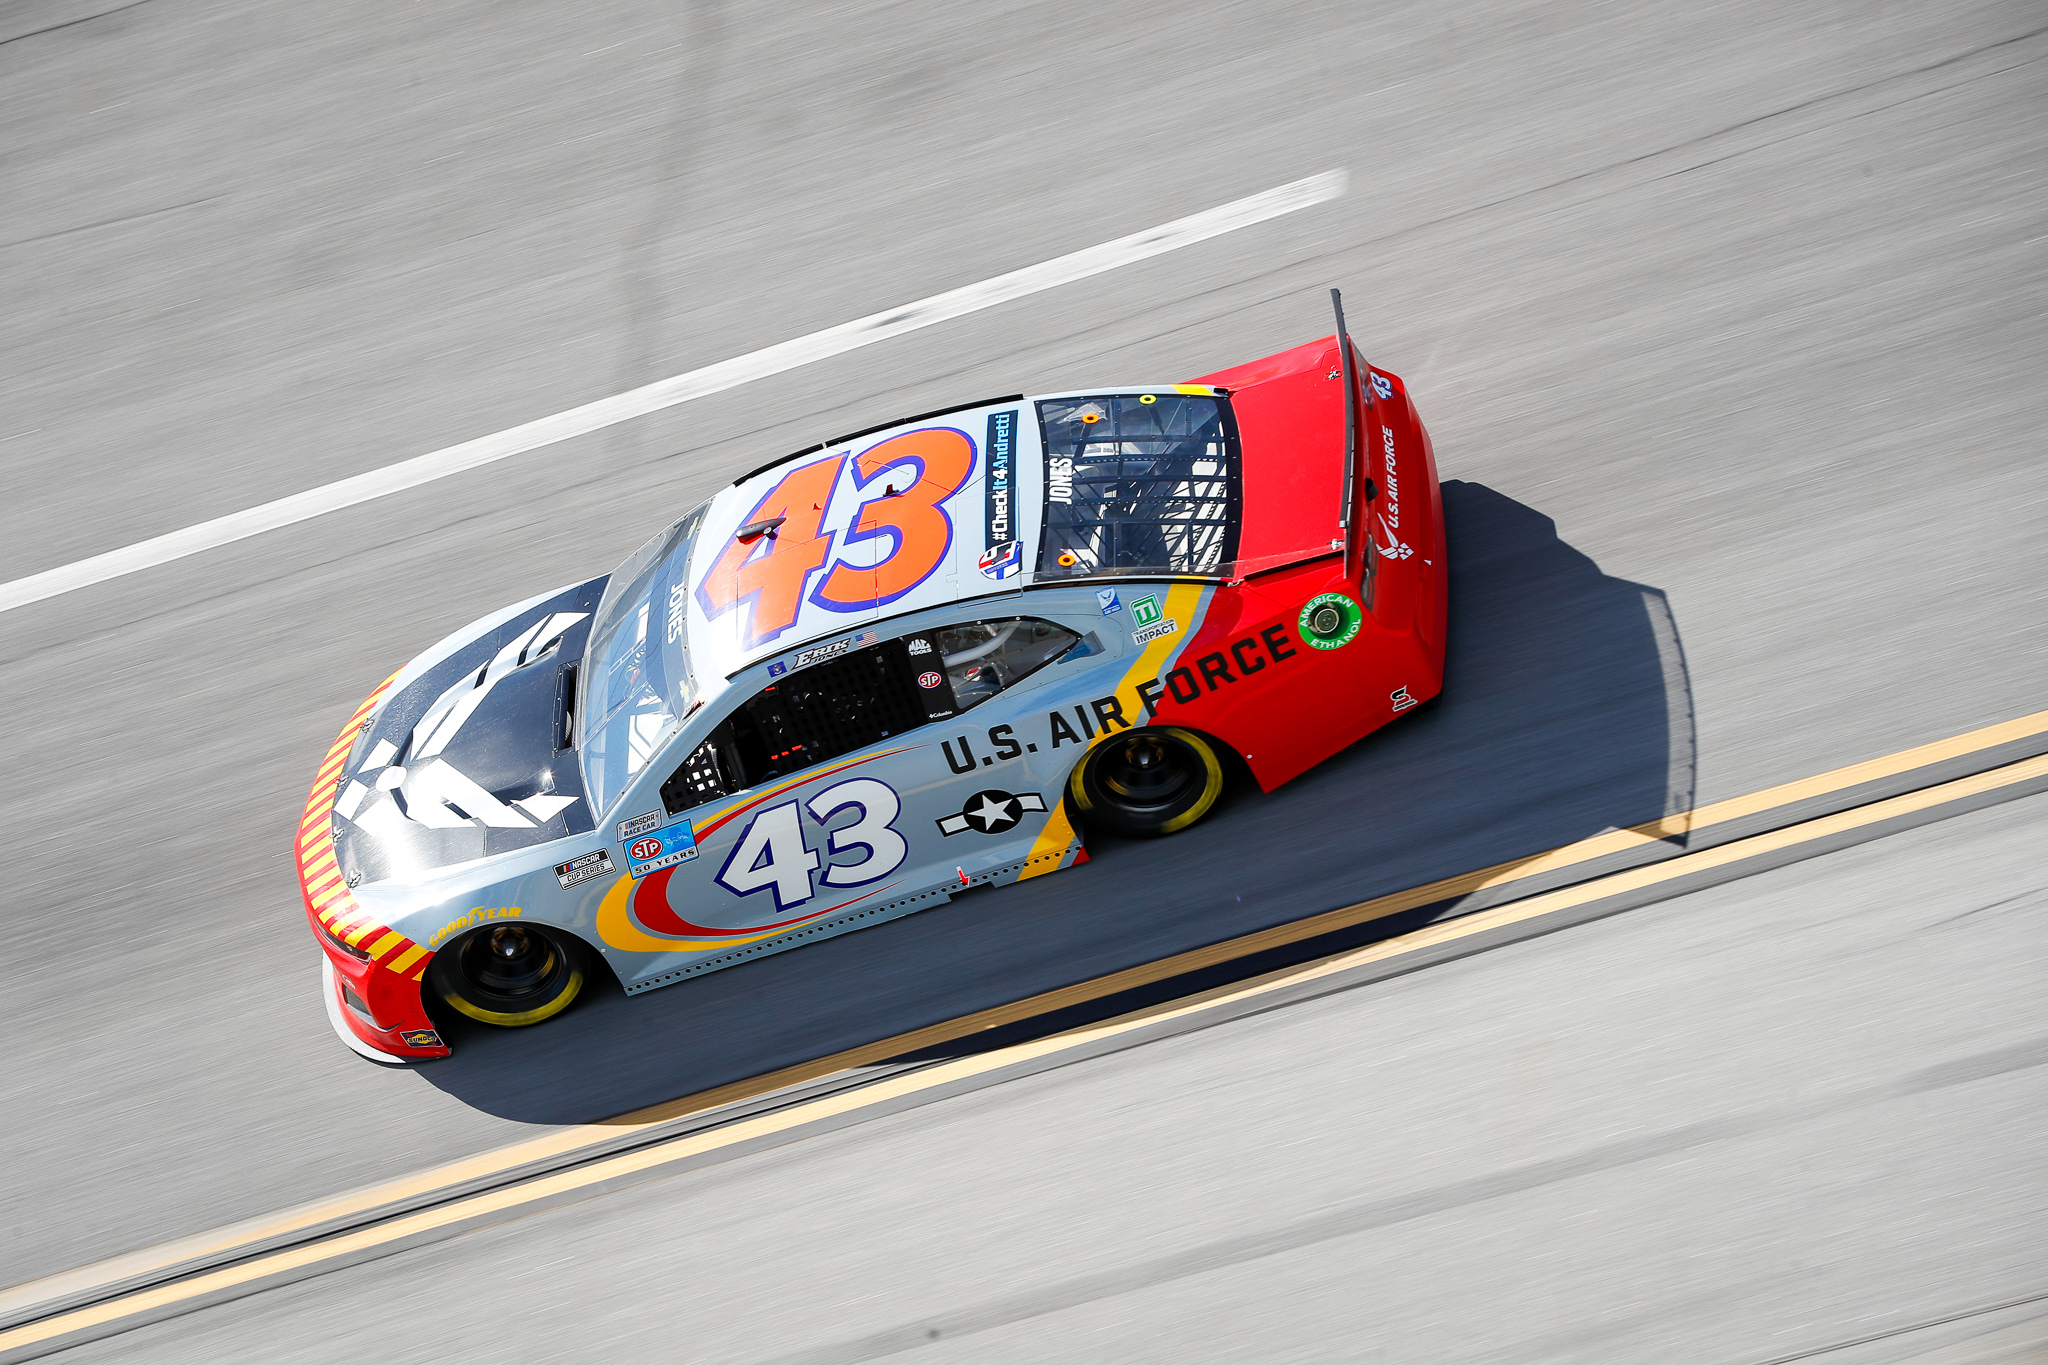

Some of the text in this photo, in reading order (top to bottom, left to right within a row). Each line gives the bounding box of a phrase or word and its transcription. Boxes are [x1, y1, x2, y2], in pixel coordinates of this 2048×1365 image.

[1370, 371, 1394, 400] 43
[992, 413, 1010, 541] #CheckIt4Andretti
[1049, 457, 1073, 505] JONES
[1382, 425, 1399, 528] U.S. AIR FORCE
[694, 426, 978, 652] 43
[667, 582, 684, 645] JONES
[1299, 595, 1354, 627] AMERICAN
[908, 639, 931, 652] MAC
[1136, 623, 1175, 645] IMPACT
[1310, 619, 1361, 648] ETHANOL
[792, 638, 851, 669] ERIK
[909, 648, 932, 656] TOOLS
[921, 674, 939, 686] STP
[941, 623, 1297, 775] U.S. AIR FORCE
[624, 822, 656, 837] RACE CAR
[630, 814, 655, 829] NASCAR
[633, 840, 659, 858] STP
[713, 776, 909, 914] 43
[567, 863, 605, 882] CUP SERIES
[572, 853, 600, 871] NASCAR
[635, 850, 695, 873] 50 YEARS
[408, 1035, 436, 1043] SUNOCO
